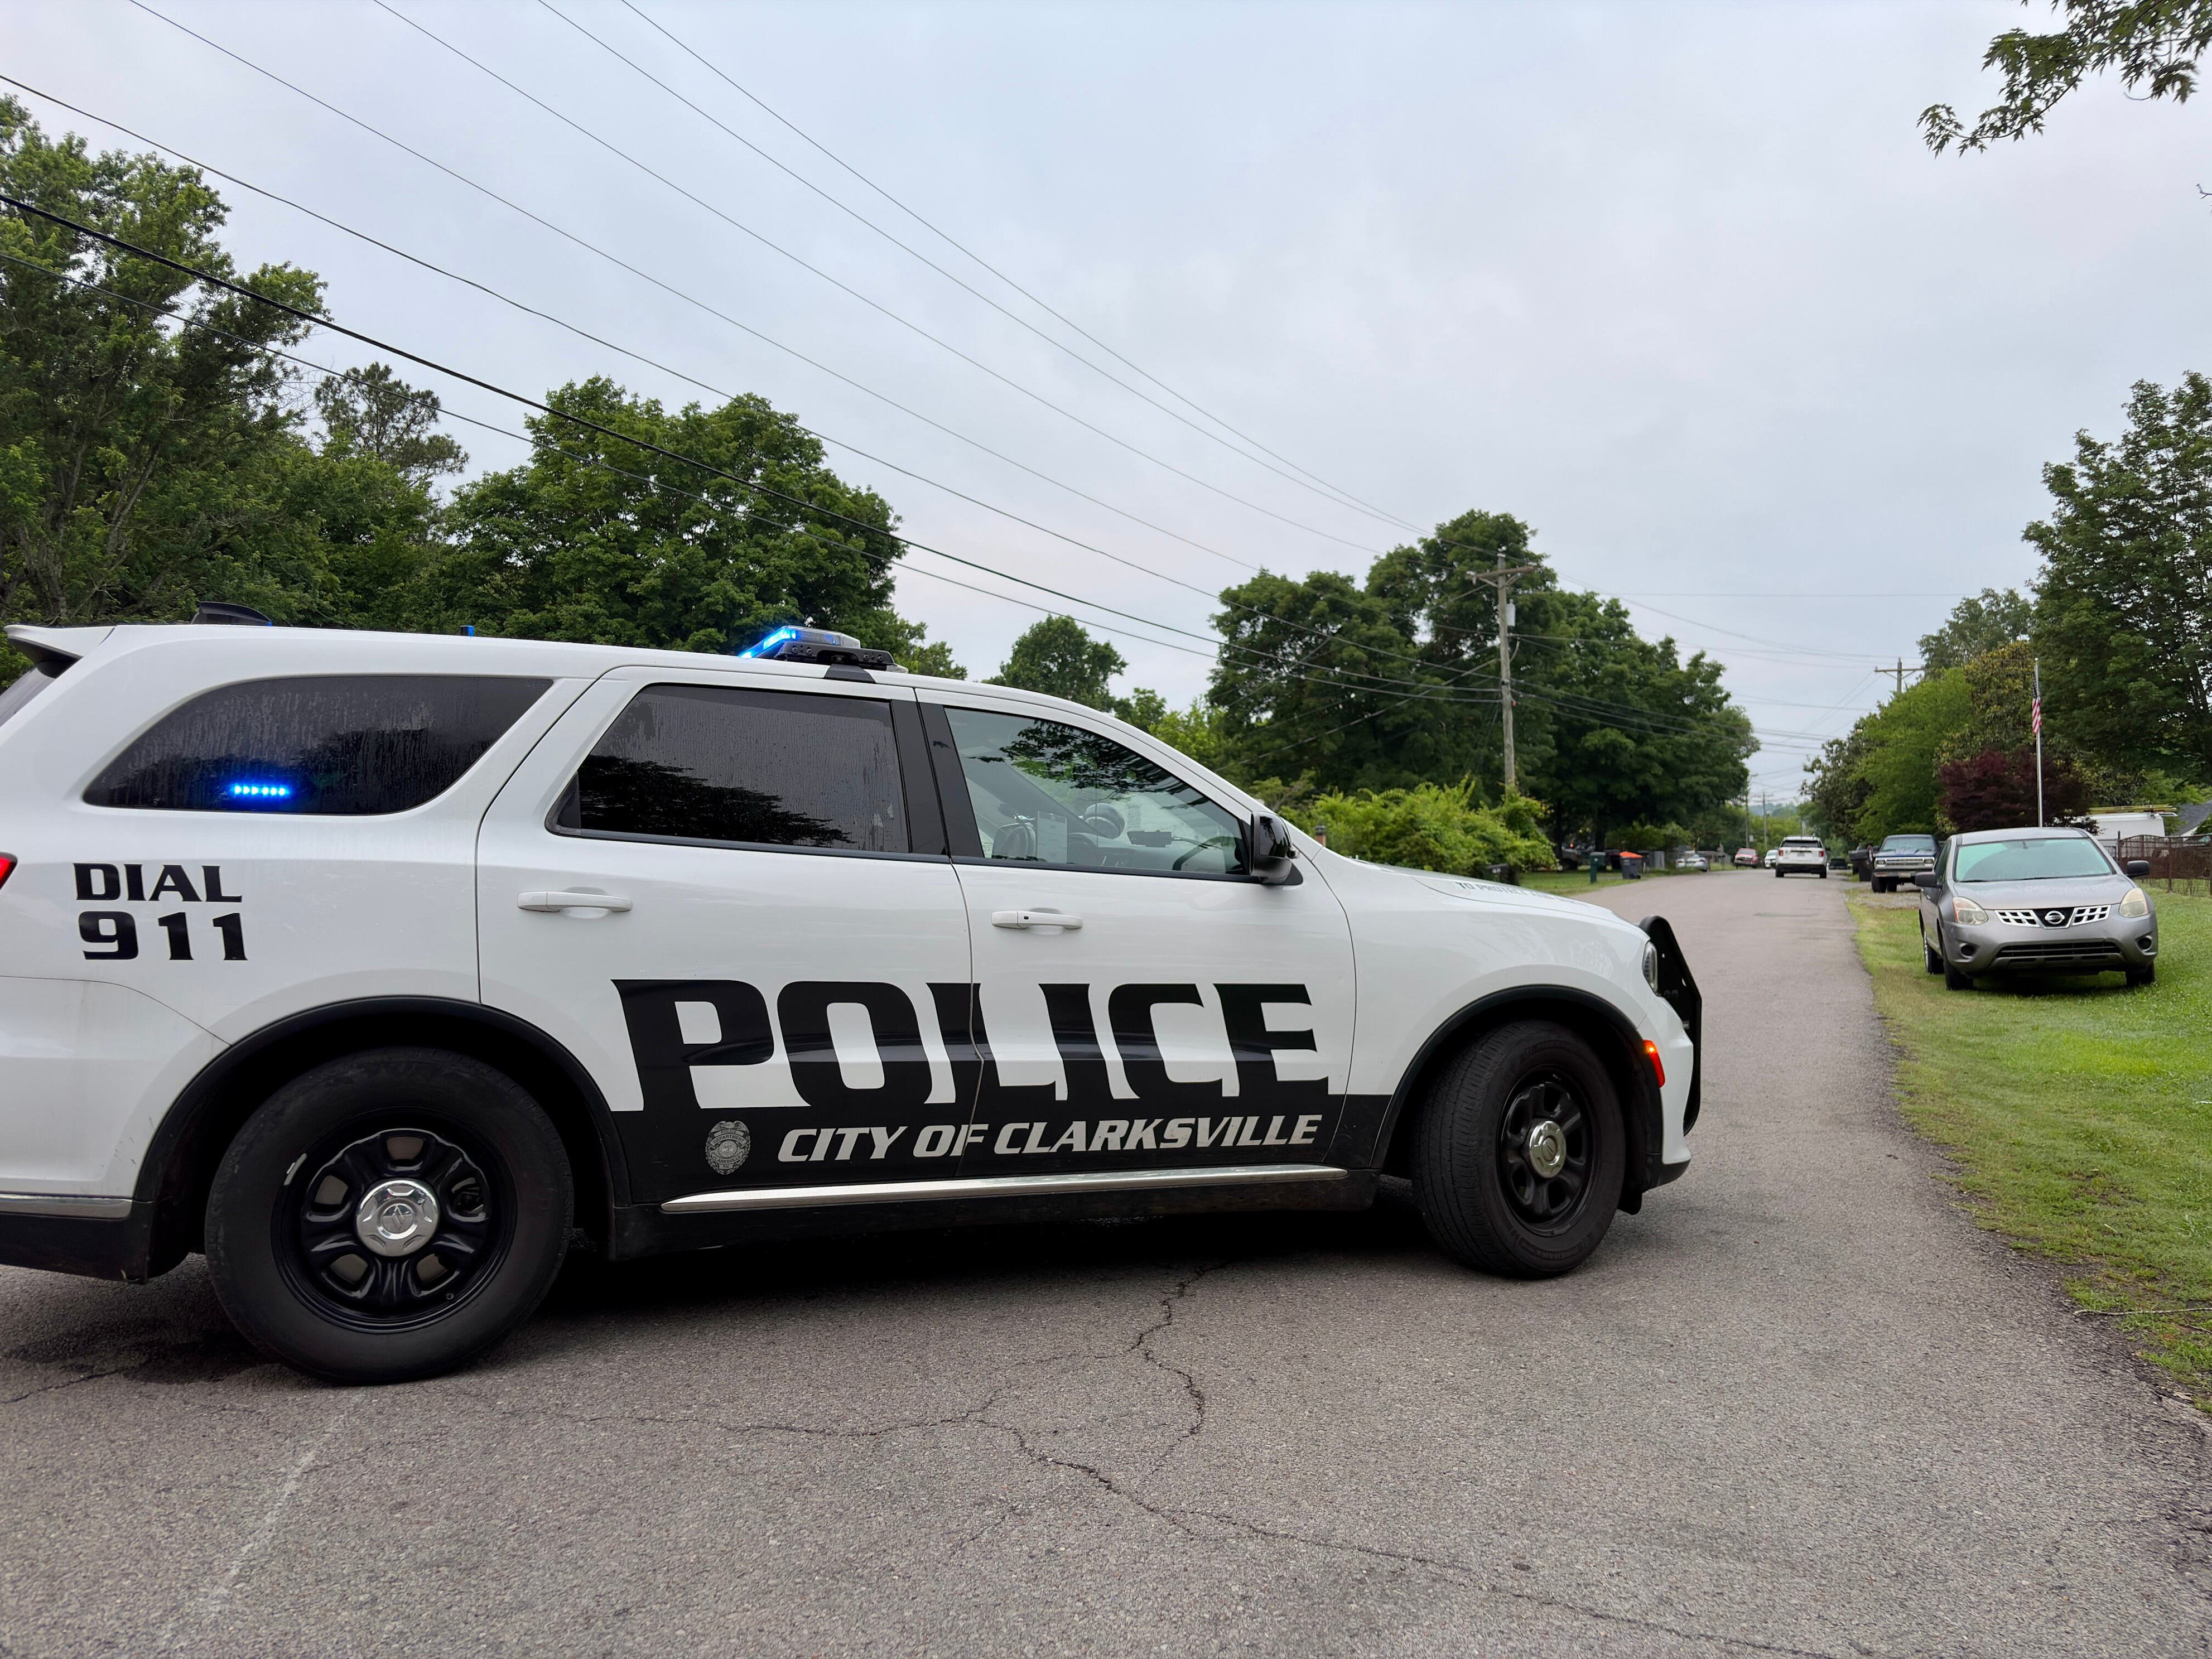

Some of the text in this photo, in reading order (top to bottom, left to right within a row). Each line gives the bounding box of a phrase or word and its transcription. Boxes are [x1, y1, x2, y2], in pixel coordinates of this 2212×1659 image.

[73, 863, 242, 902] DIAL
[78, 911, 248, 961] 911
[611, 979, 1328, 1111] POLICE
[712, 1155, 741, 1164] CLARKSVILLE
[713, 1135, 744, 1144] DEPARTMENT
[778, 1114, 1322, 1162] CITY OF CLARKSVILLE
